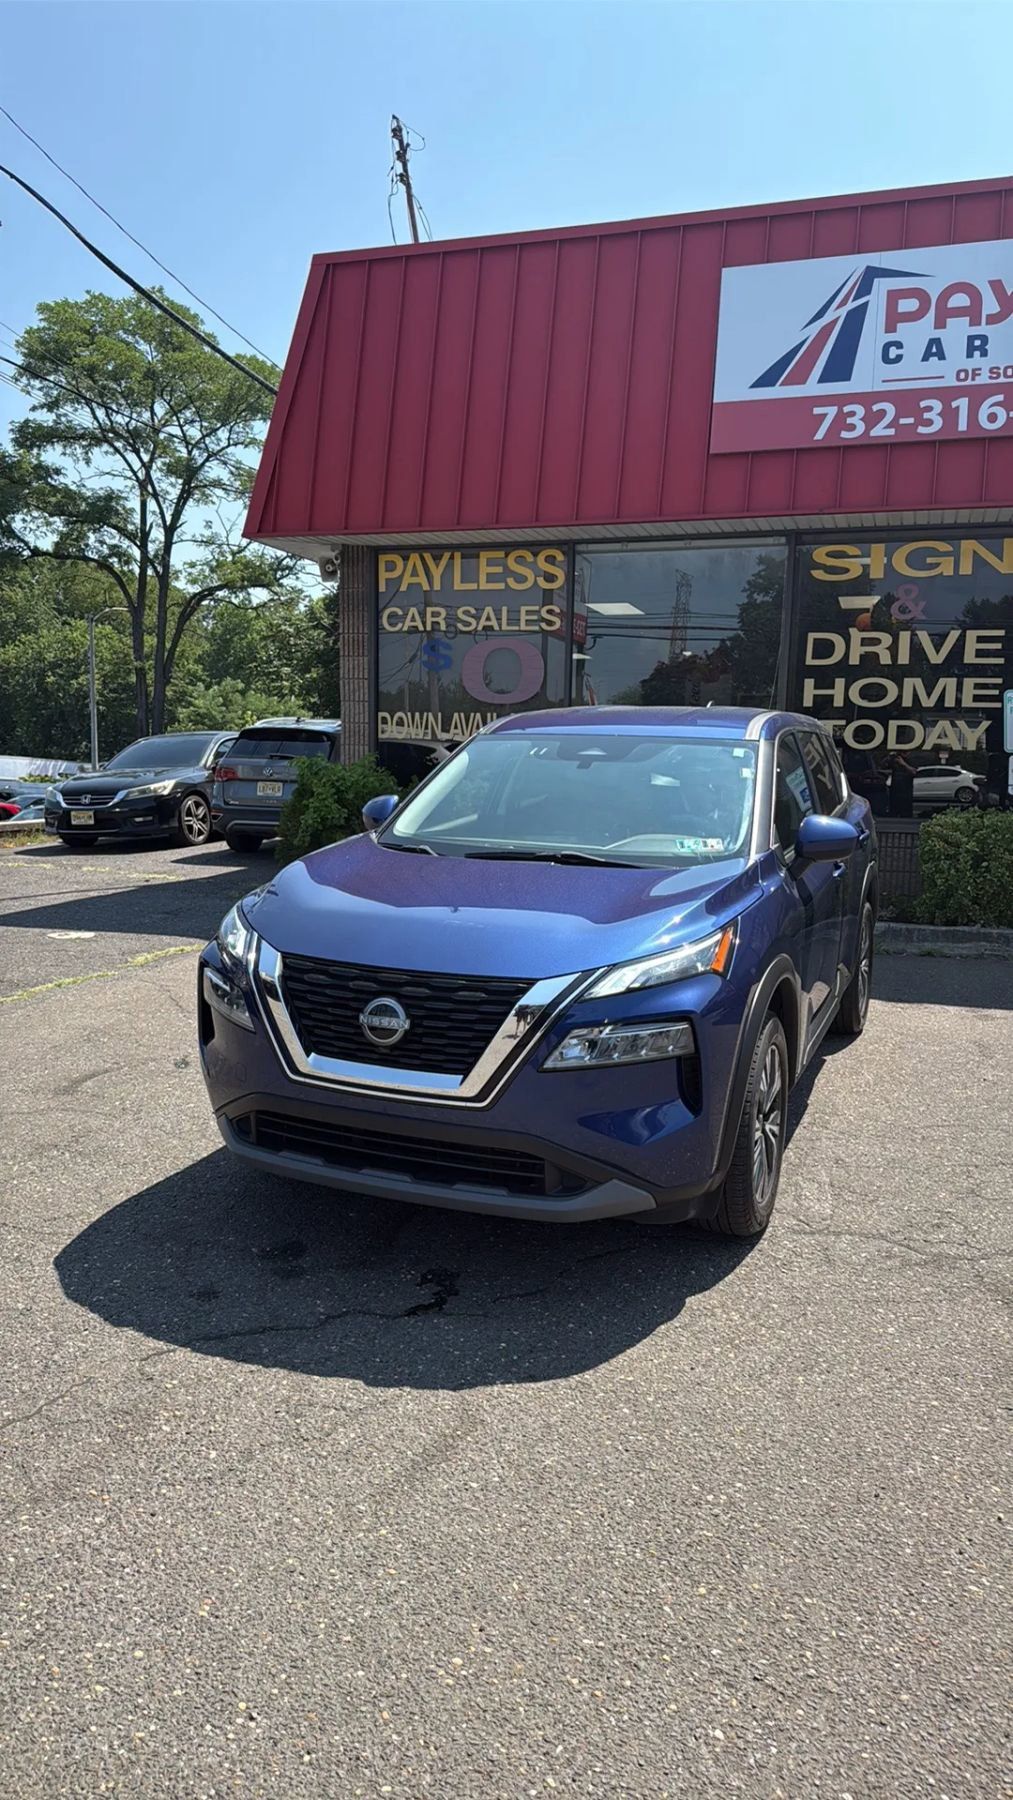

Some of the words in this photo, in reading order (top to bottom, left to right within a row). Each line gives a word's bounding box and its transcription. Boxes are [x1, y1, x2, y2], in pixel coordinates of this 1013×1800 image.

[881, 334, 989, 365] CAR
[955, 368, 981, 382] OF
[812, 394, 1013, 440] 732-316
[379, 549, 565, 591] PAYLESS
[810, 538, 1013, 581] SIGN
[890, 583, 927, 620] &
[382, 606, 447, 632] CAR
[456, 605, 562, 632] SALES
[805, 628, 1006, 666] DRIVE
[802, 677, 1003, 708] HOME
[377, 711, 442, 740] DOWN
[360, 1014, 411, 1030] NISSAN
